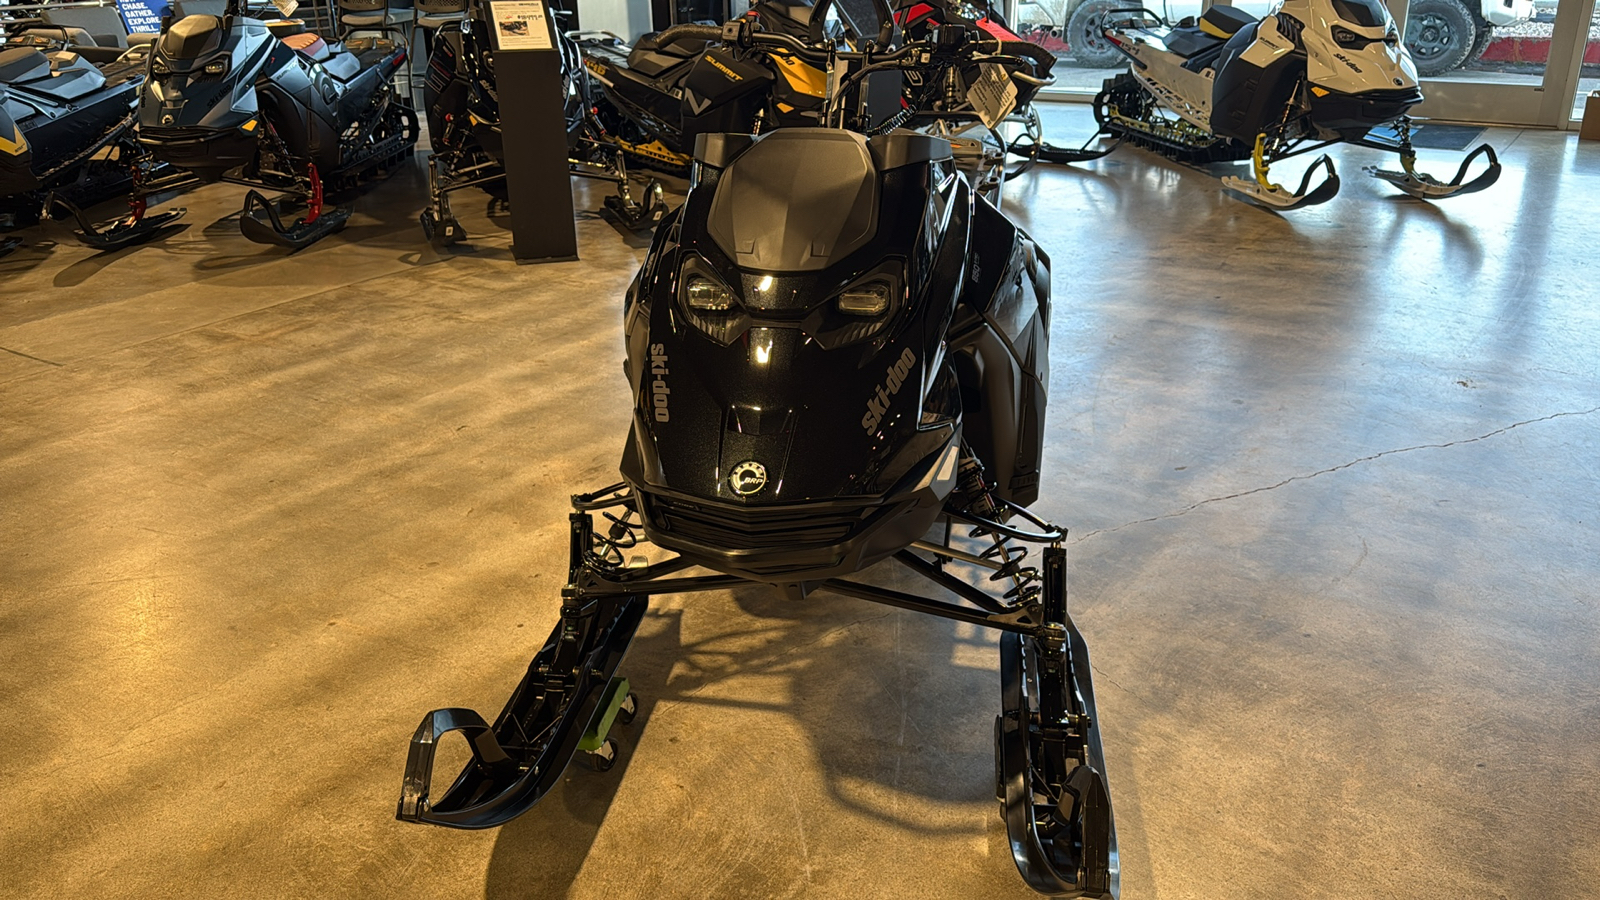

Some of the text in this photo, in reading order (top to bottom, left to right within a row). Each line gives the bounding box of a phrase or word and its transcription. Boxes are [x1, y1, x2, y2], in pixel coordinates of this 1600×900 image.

[121, 2, 148, 10] CHASE.
[125, 9, 155, 18] GATHER.
[131, 24, 158, 33] THRILL.
[705, 55, 744, 81] SUMMIT
[1333, 52, 1363, 74] ski-doo
[650, 343, 671, 423] ski-doo
[861, 347, 917, 436] ski-doo
[743, 476, 764, 485] BRP
